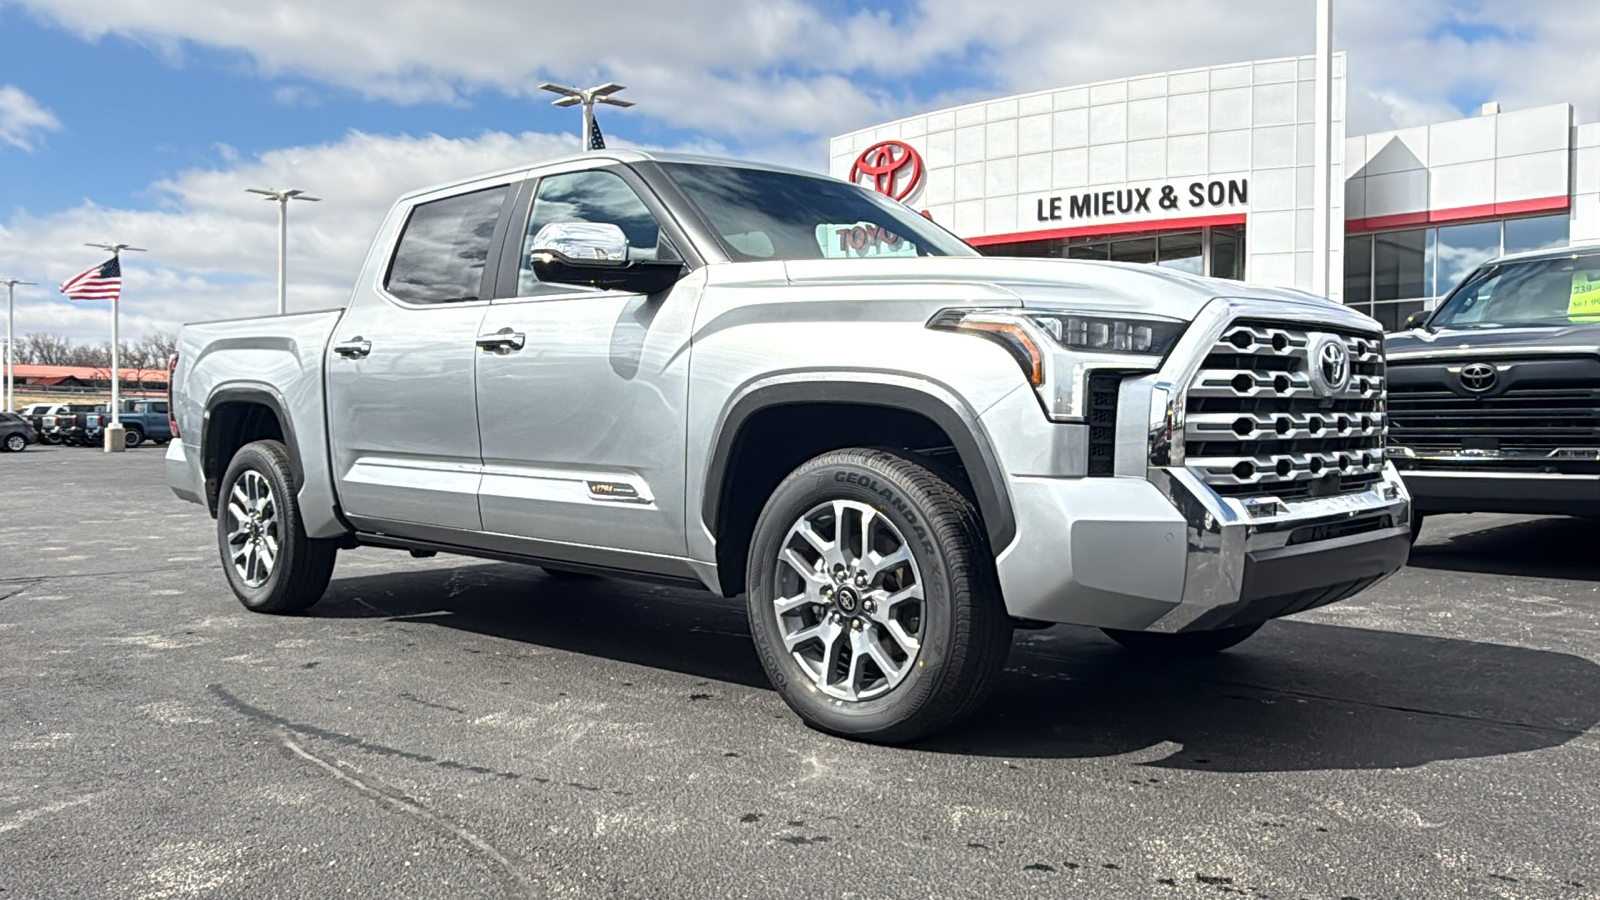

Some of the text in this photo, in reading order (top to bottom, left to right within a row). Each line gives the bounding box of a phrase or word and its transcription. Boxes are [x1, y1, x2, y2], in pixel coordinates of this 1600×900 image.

[1037, 178, 1248, 221] LE MIEUX & SON
[834, 471, 935, 556] GEOLANDAR
